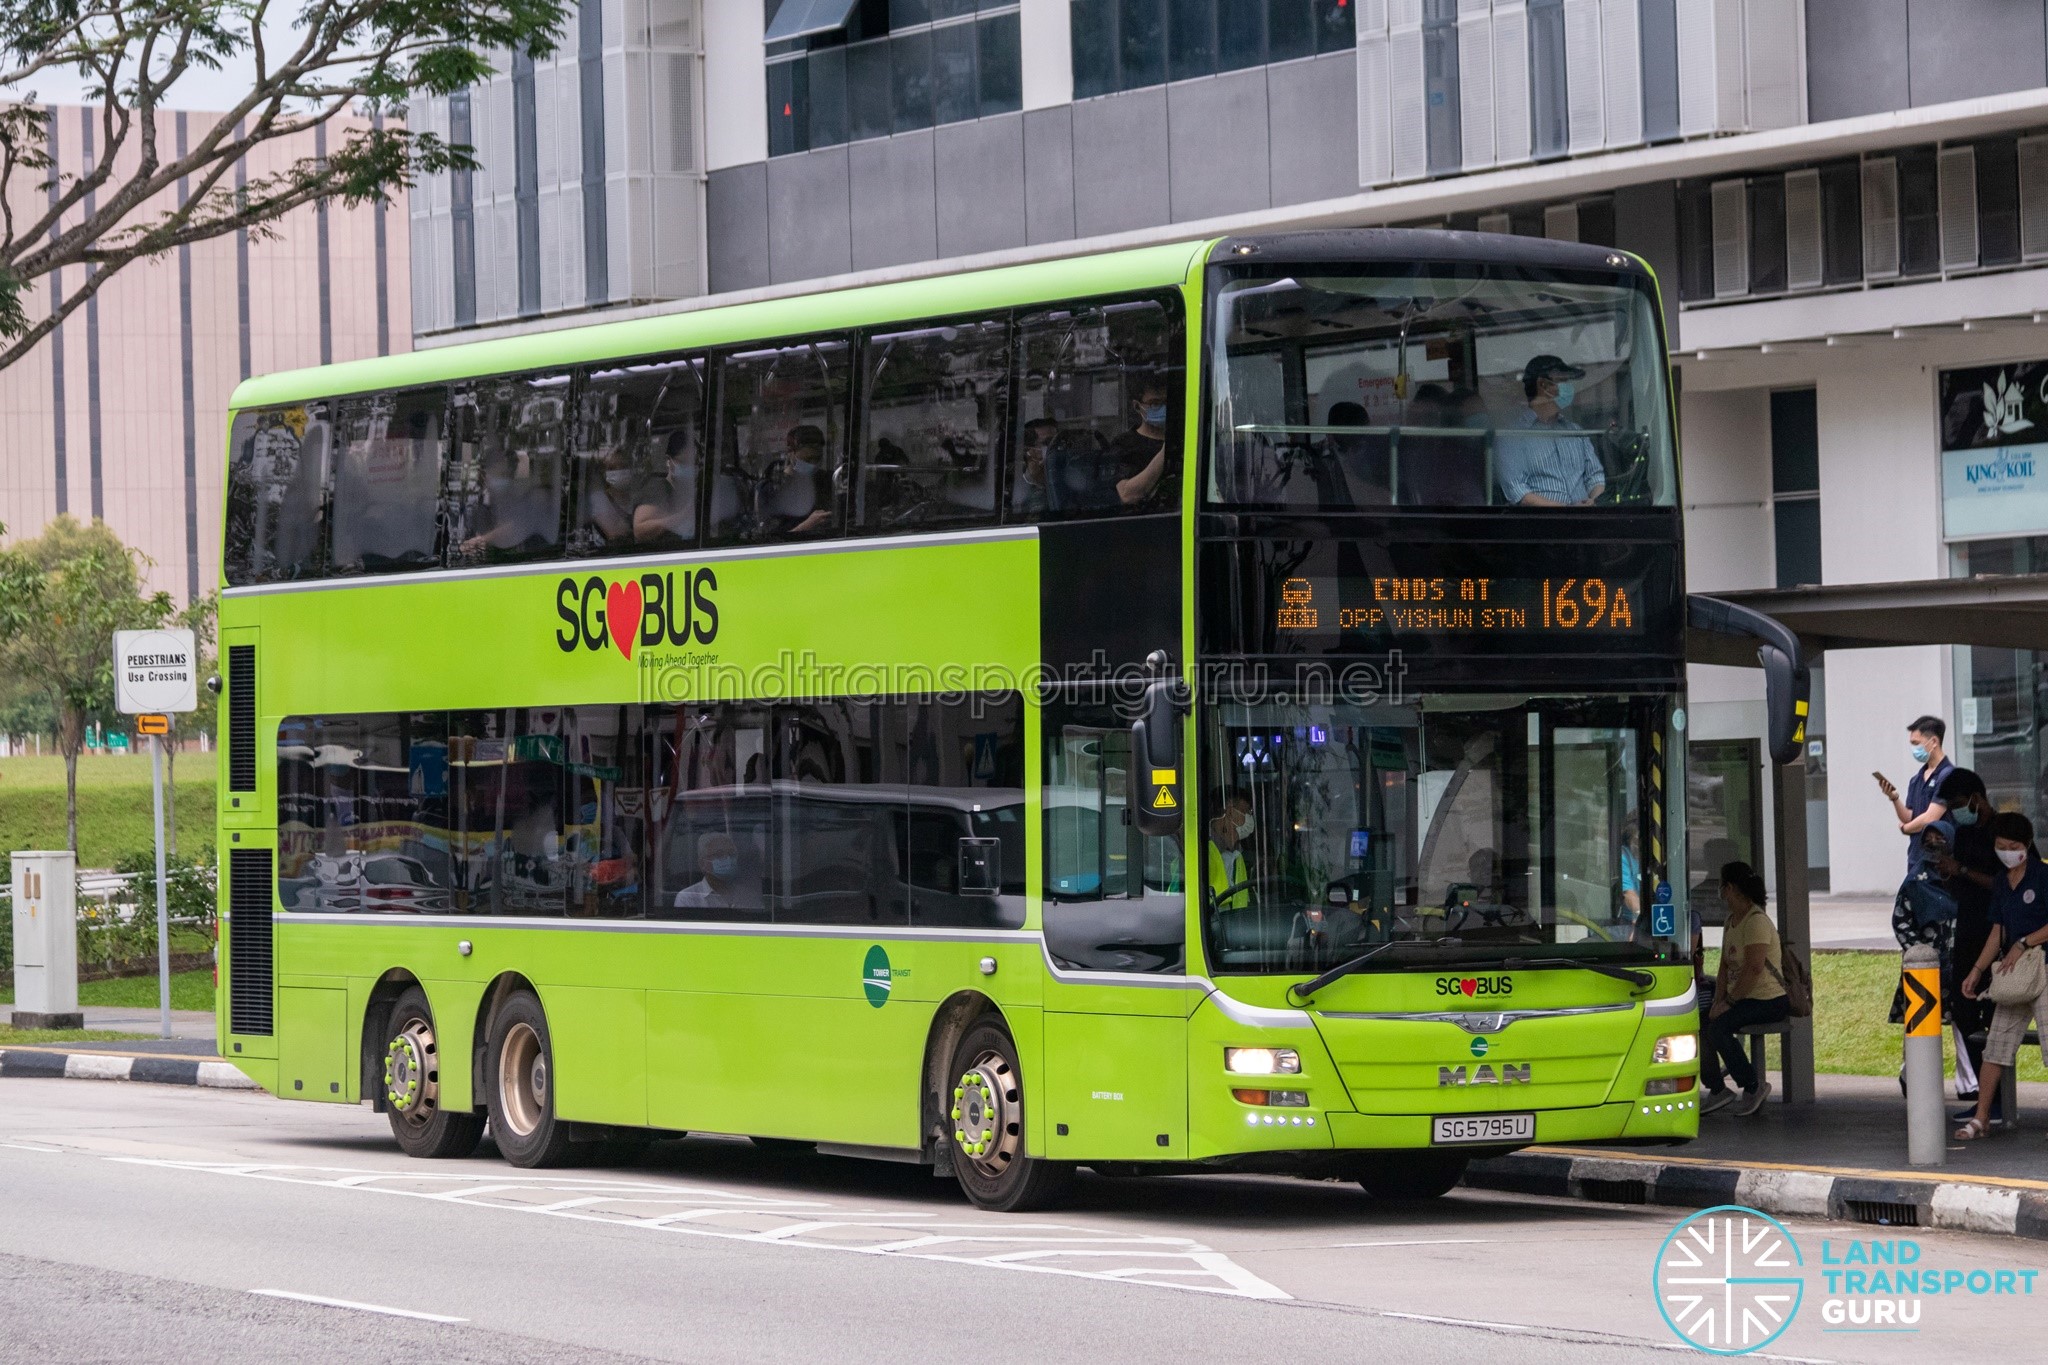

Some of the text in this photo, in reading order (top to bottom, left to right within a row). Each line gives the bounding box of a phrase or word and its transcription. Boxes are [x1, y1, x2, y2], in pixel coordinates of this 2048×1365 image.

[1966, 461, 2034, 484] KING KOIL
[1374, 578, 1489, 600] ENDS AT
[640, 567, 719, 647] BUS
[1543, 578, 1632, 628] 169A
[1339, 608, 1526, 628] OPP YISHUN STN
[127, 654, 187, 665] PEDESTRIANS
[664, 653, 687, 667] Ahead
[688, 652, 719, 669] Together
[128, 670, 187, 682] Use Crossing
[872, 968, 890, 977] TOWER
[1476, 975, 1513, 995] BUS
[1438, 1063, 1531, 1087] MAN
[1441, 1118, 1527, 1138] SG5795U
